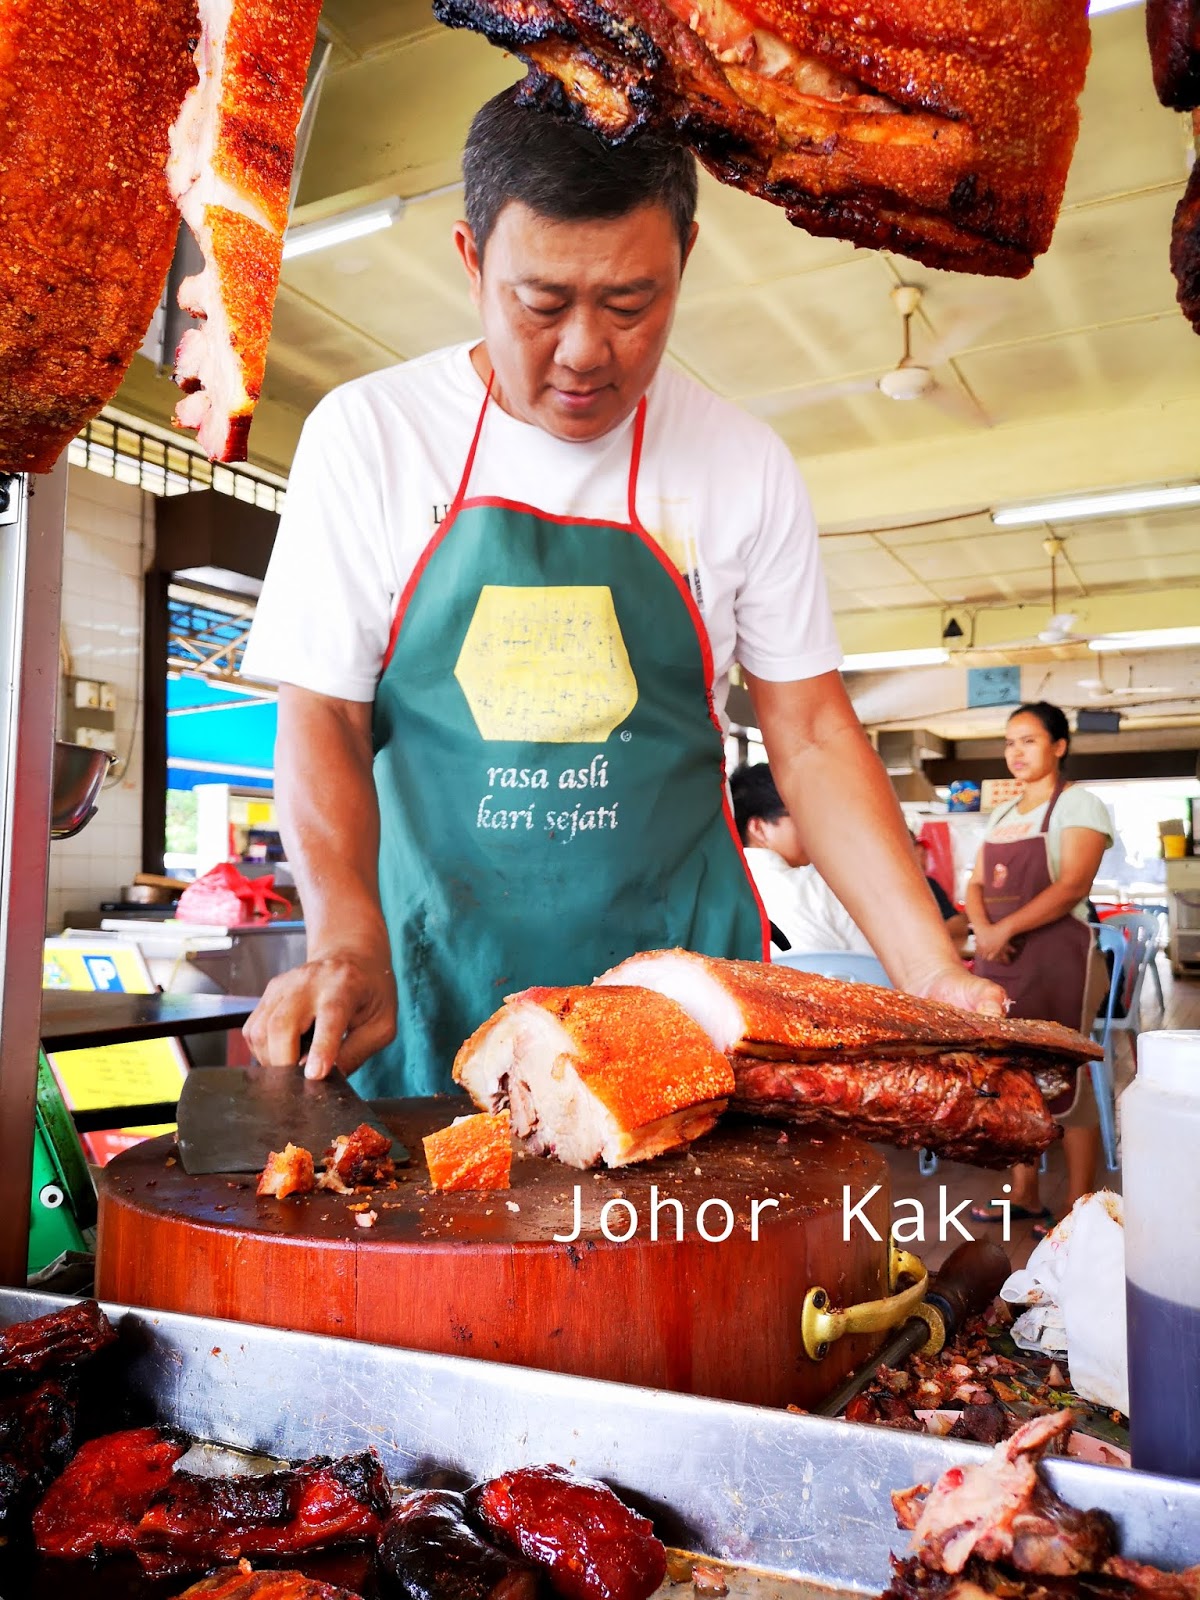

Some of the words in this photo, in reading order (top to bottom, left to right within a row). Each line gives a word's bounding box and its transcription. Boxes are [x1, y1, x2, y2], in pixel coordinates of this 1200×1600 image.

[486, 766, 550, 789] rasa
[558, 754, 609, 789] asli
[476, 794, 536, 830] kari
[543, 802, 619, 845] sejati
[88, 958, 117, 990] P
